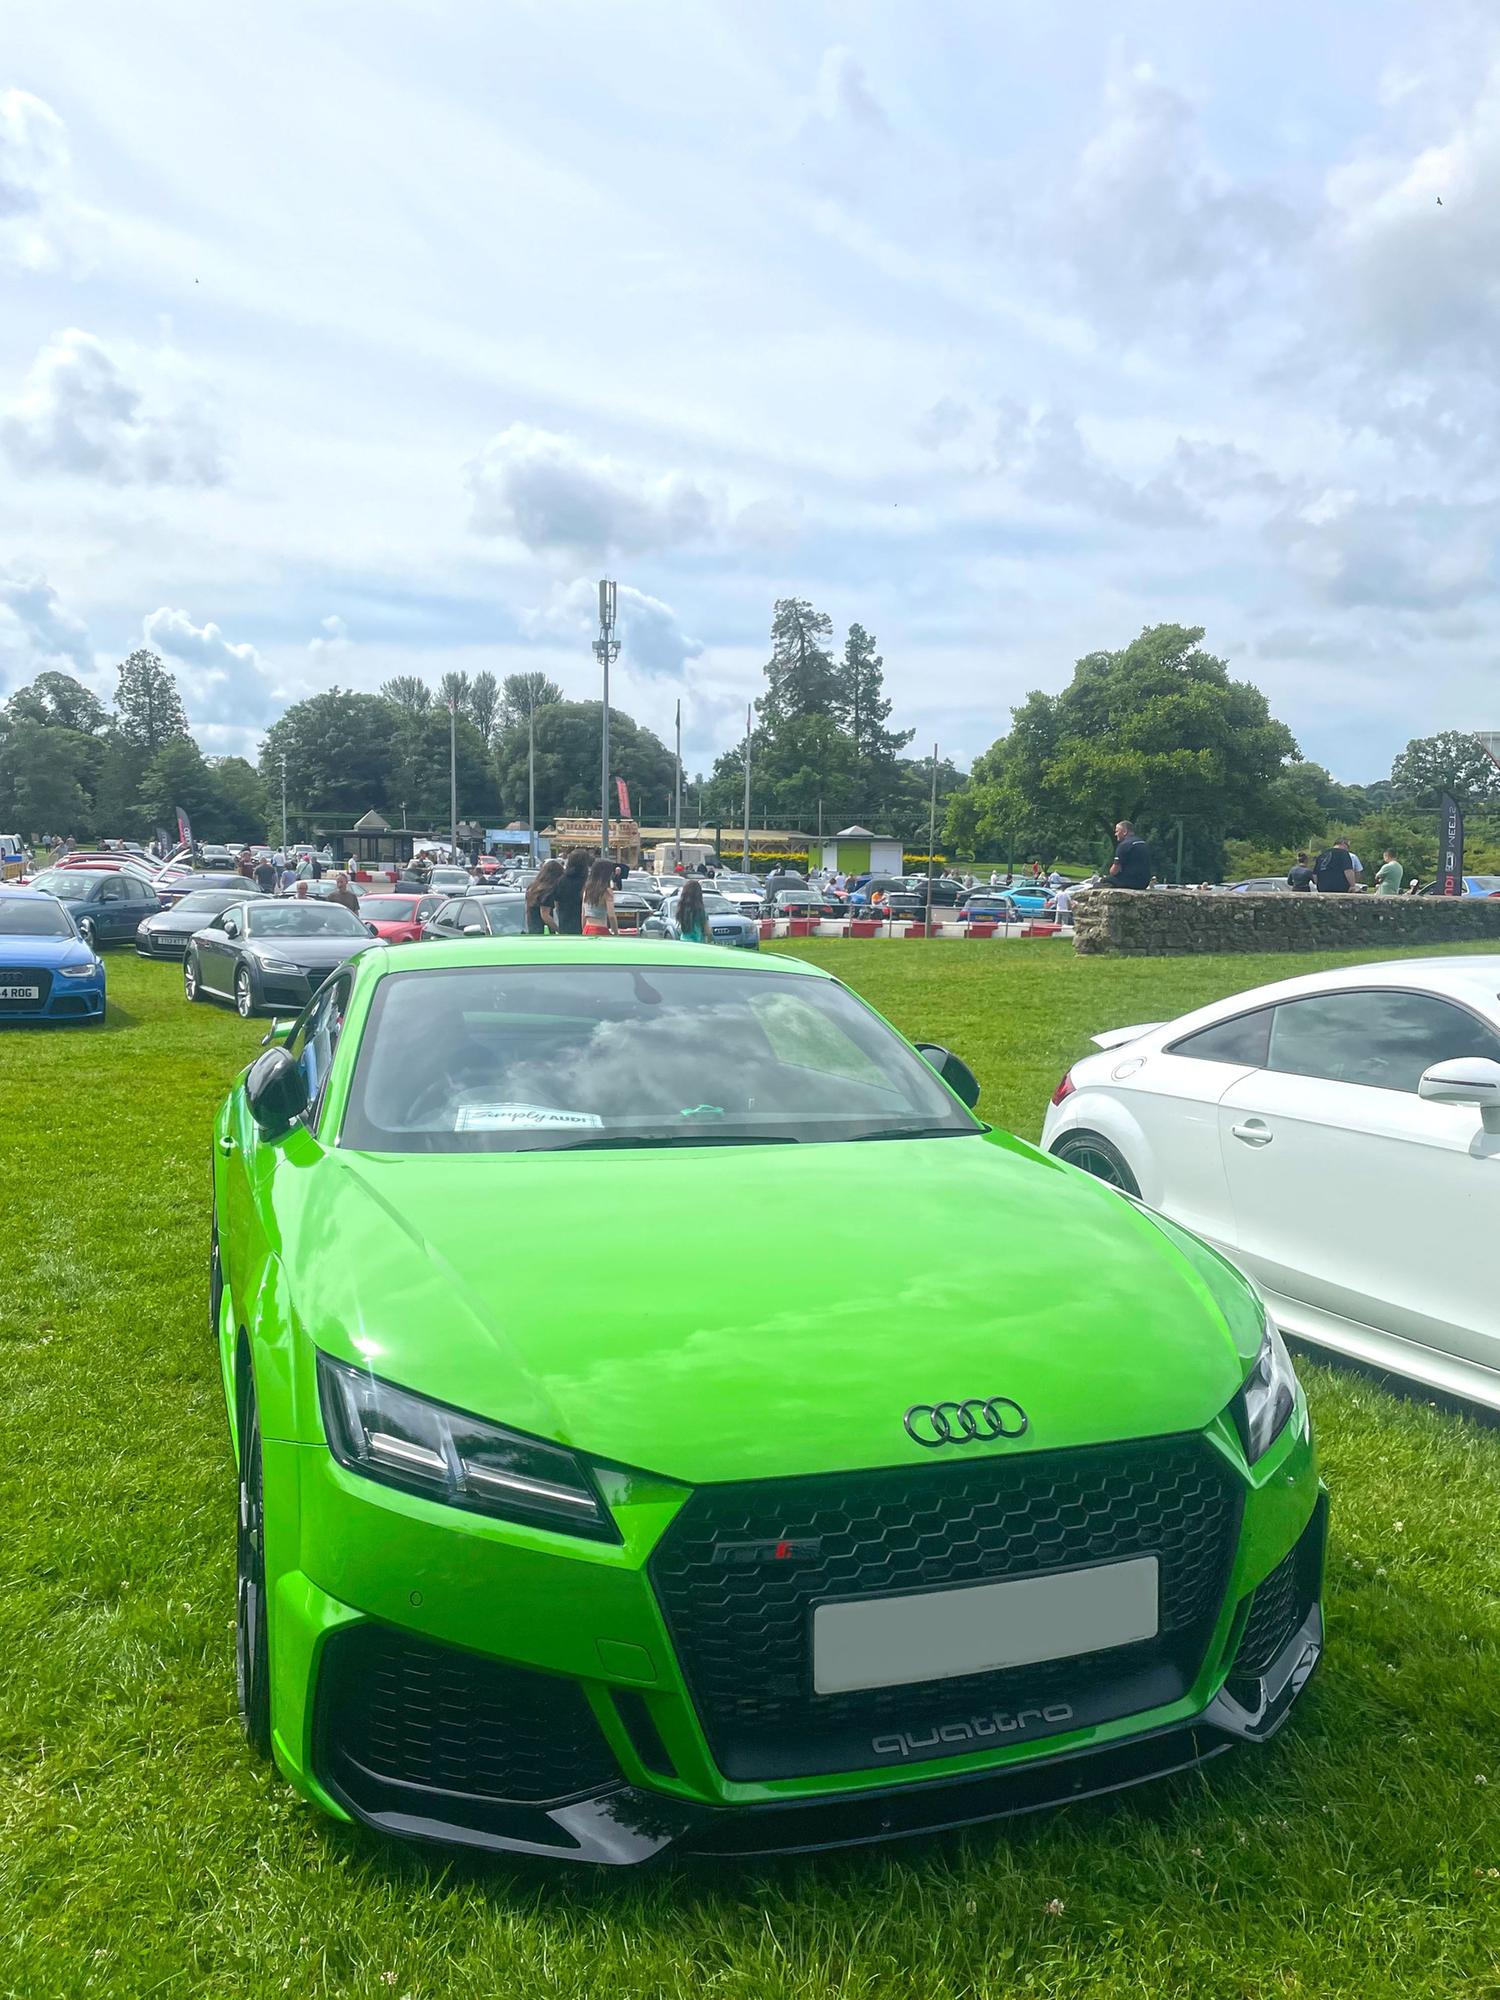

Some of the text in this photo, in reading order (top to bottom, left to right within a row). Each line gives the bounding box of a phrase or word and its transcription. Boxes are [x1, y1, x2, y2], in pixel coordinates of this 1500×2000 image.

[11, 988, 32, 998] ROG
[471, 1111, 587, 1123] Simply AUDI
[872, 1703, 1074, 1756] quattro
